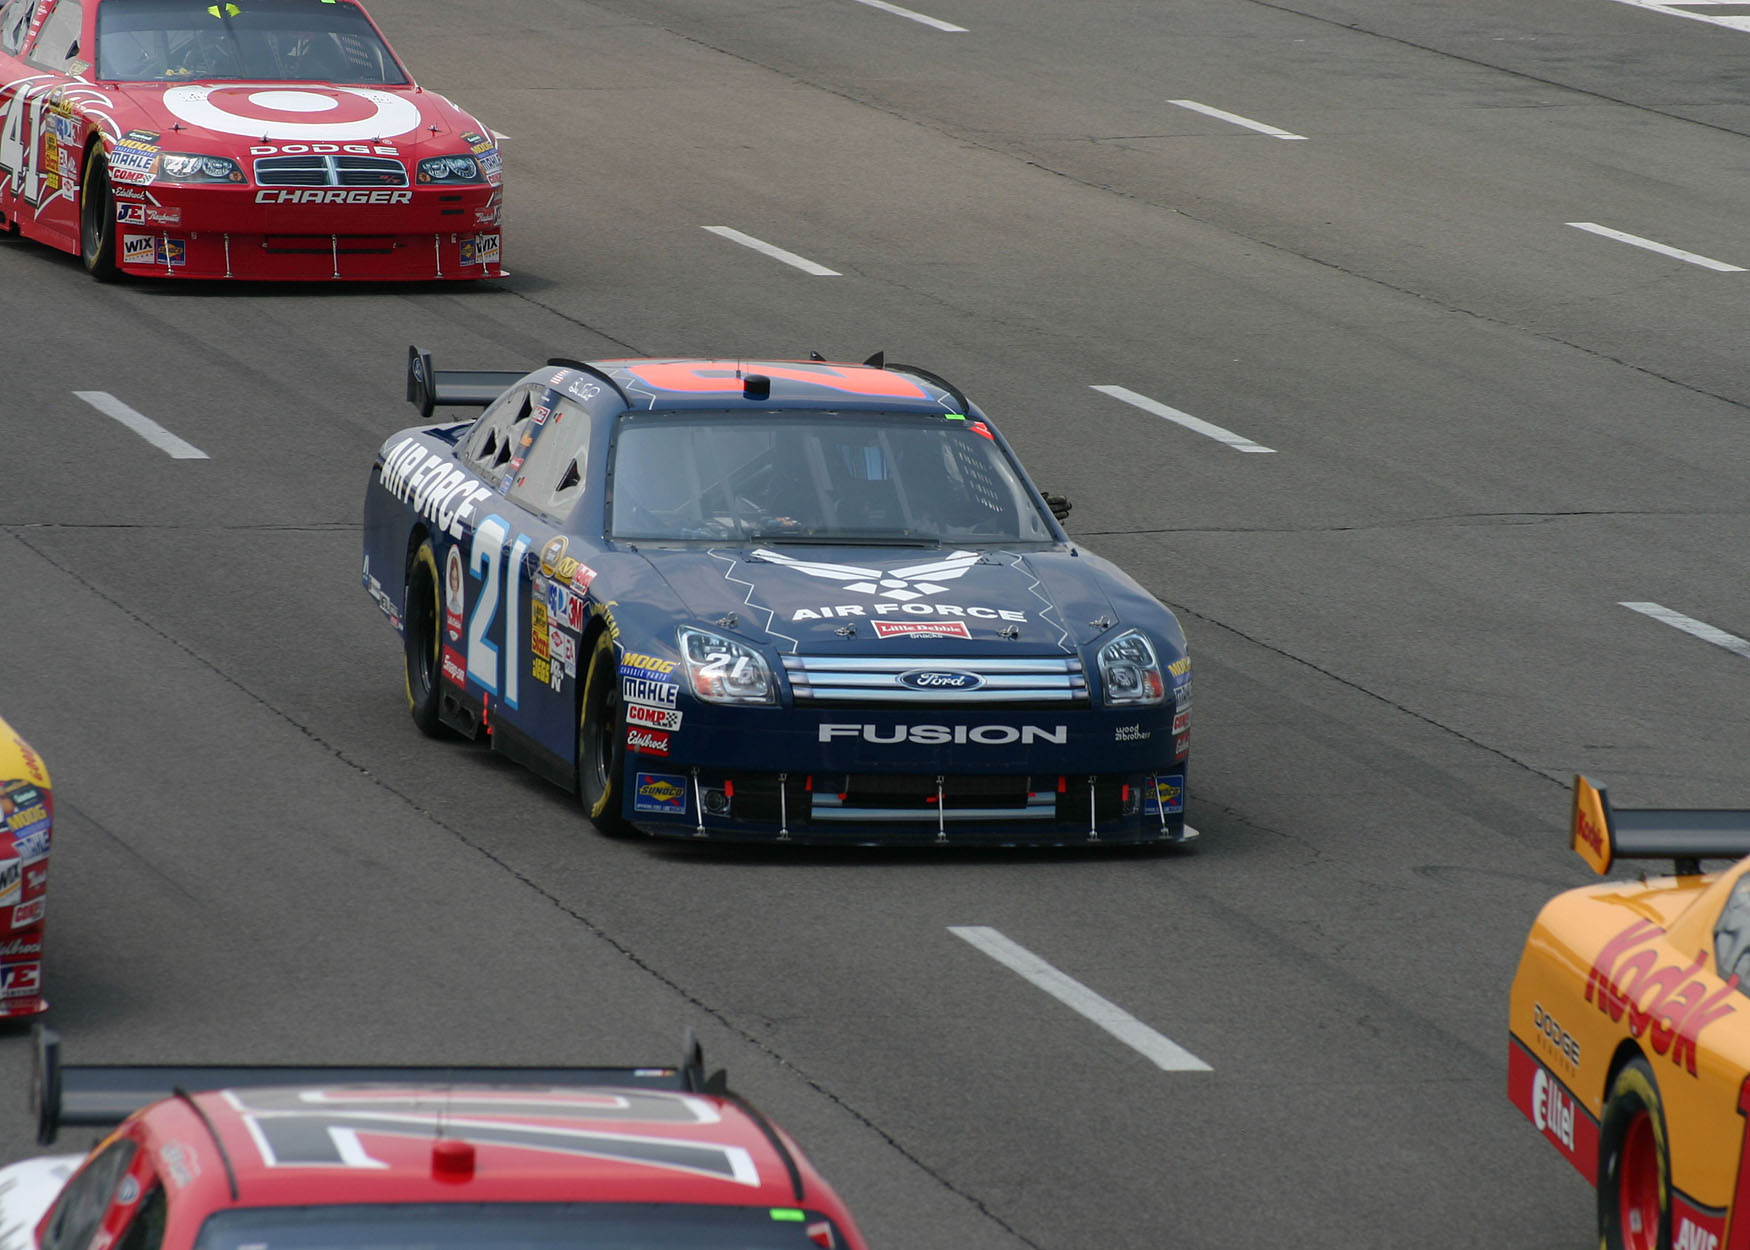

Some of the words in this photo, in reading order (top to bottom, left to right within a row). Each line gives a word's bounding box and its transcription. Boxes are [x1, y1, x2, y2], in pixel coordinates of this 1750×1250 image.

[118, 139, 160, 152] MOOG
[249, 144, 400, 156] DODGE
[110, 152, 153, 169] MAHLE
[165, 155, 198, 173] 41
[113, 168, 144, 180] COMP
[115, 187, 145, 200] Edelbrock
[255, 190, 413, 204] CHARGER
[118, 204, 143, 220] JE
[125, 237, 153, 253] WIX
[477, 236, 499, 254] WIX
[380, 437, 428, 500] AIR
[404, 455, 493, 541] FORCE
[467, 514, 532, 711] 21
[569, 597, 584, 633] 3M
[792, 604, 867, 621] AIR
[874, 603, 1028, 623] FORCE
[880, 624, 914, 633] Little
[914, 624, 962, 634] Debbie
[622, 652, 678, 673] MOOG
[699, 653, 750, 678] 21
[620, 667, 644, 679] CHASSIS
[646, 671, 667, 681] PARTS
[917, 672, 965, 687] Ford
[624, 679, 677, 704] MAHLE
[629, 706, 666, 722] COMP
[818, 723, 1068, 745] FUSION
[1116, 723, 1139, 734] wood
[627, 730, 670, 751] Edelbrock
[641, 786, 684, 796] SUNOCO
[1585, 918, 1741, 1080] Kodak
[1535, 1002, 1581, 1067] DODGE
